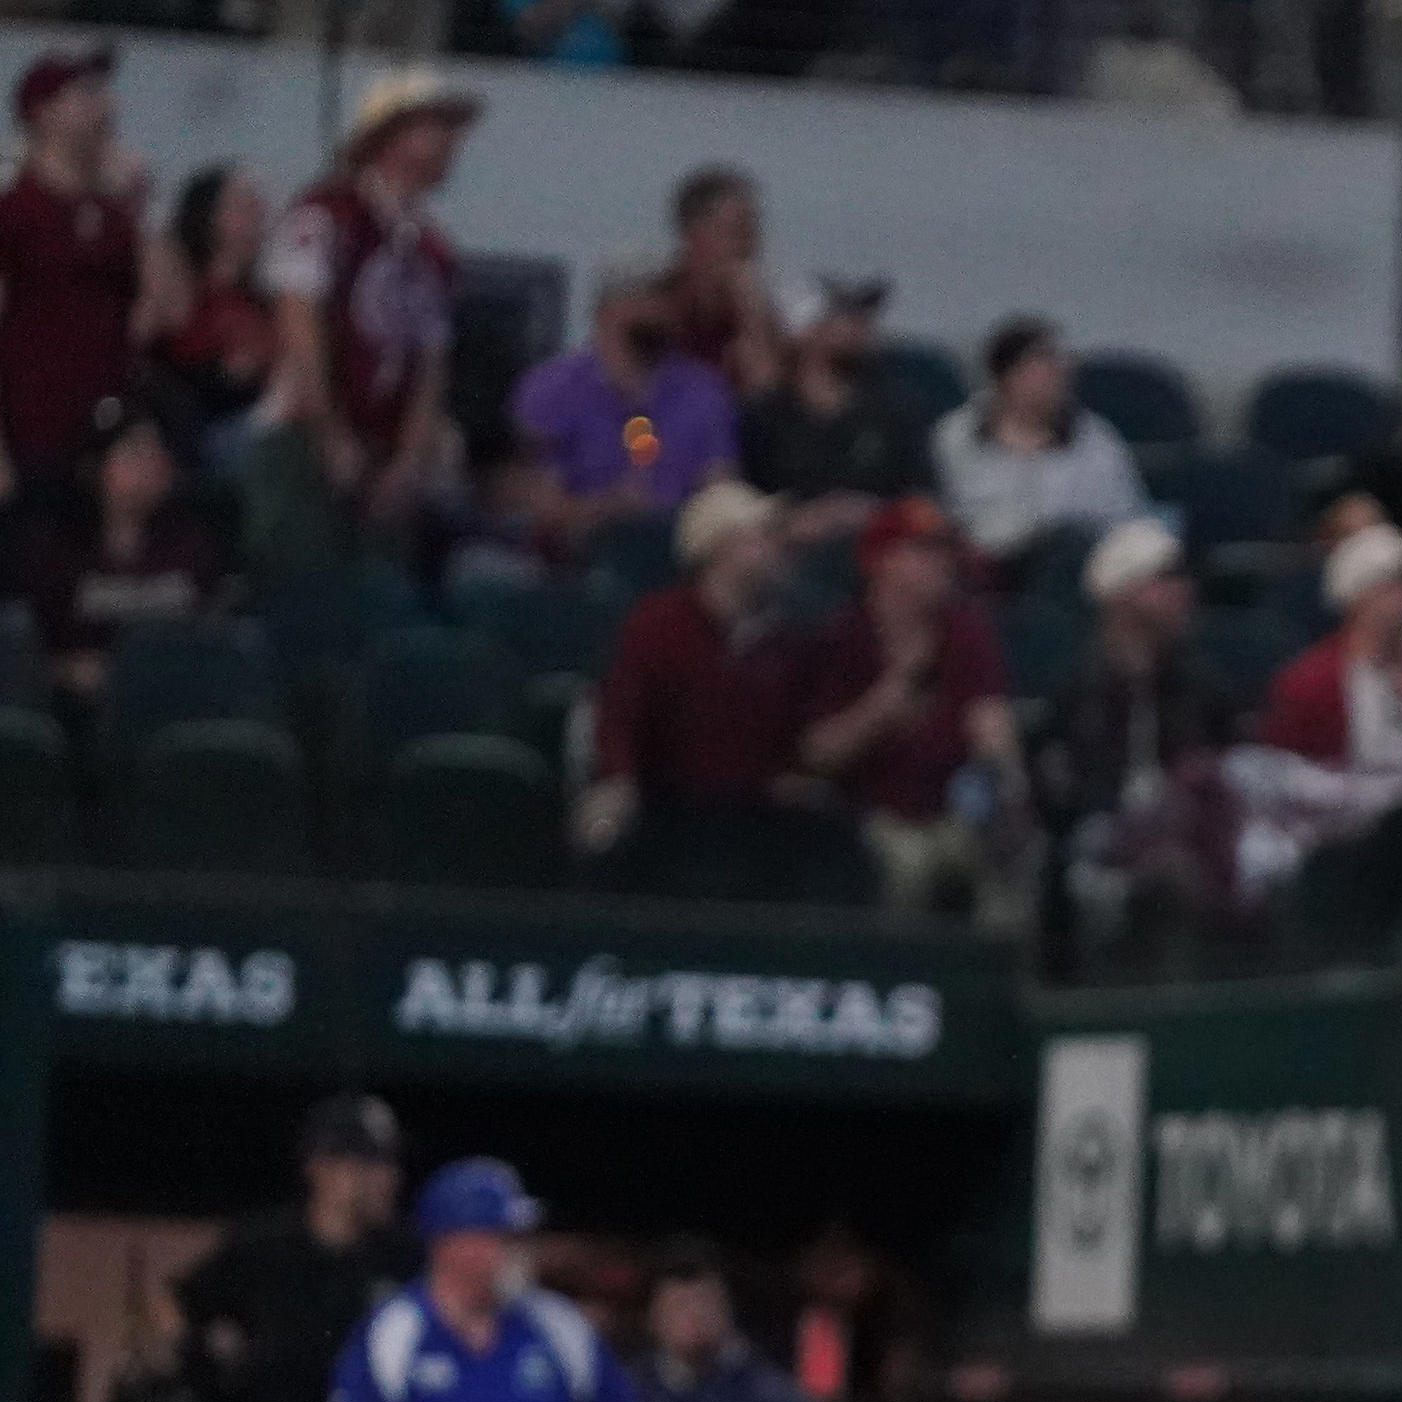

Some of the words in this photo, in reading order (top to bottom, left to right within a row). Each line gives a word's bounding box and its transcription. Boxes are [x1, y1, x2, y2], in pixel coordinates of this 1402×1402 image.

[55, 938, 297, 1025] EXAS
[397, 957, 558, 1036] ALL
[545, 952, 654, 1050] for
[658, 970, 944, 1061] TEXAS
[1153, 1107, 1396, 1252] TOYOTA
